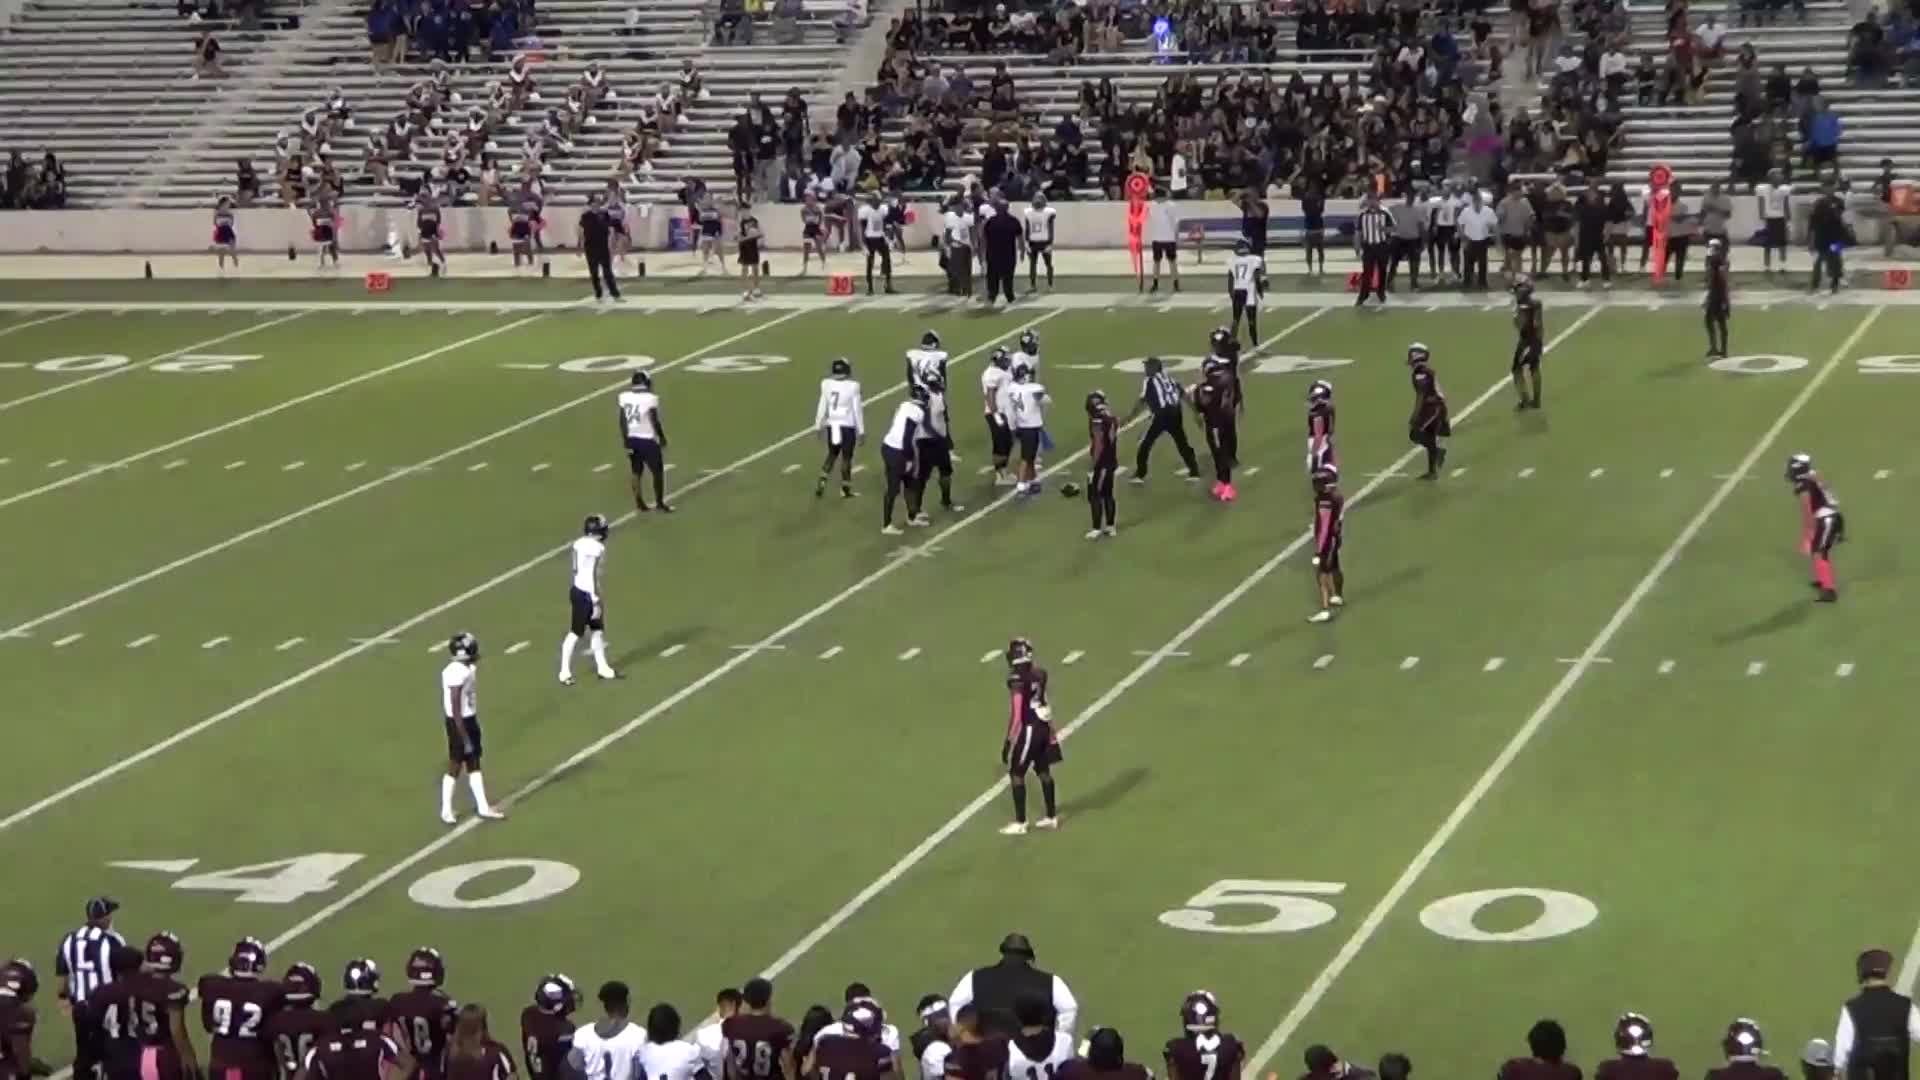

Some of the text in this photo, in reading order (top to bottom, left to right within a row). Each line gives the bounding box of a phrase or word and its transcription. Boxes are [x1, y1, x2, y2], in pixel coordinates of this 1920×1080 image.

[1234, 263, 1249, 280] 17
[830, 391, 840, 411] 7
[171, 852, 581, 909] 40
[1157, 878, 1600, 942] 50
[213, 998, 262, 1037] 92
[1200, 1054, 1218, 1080] 7
